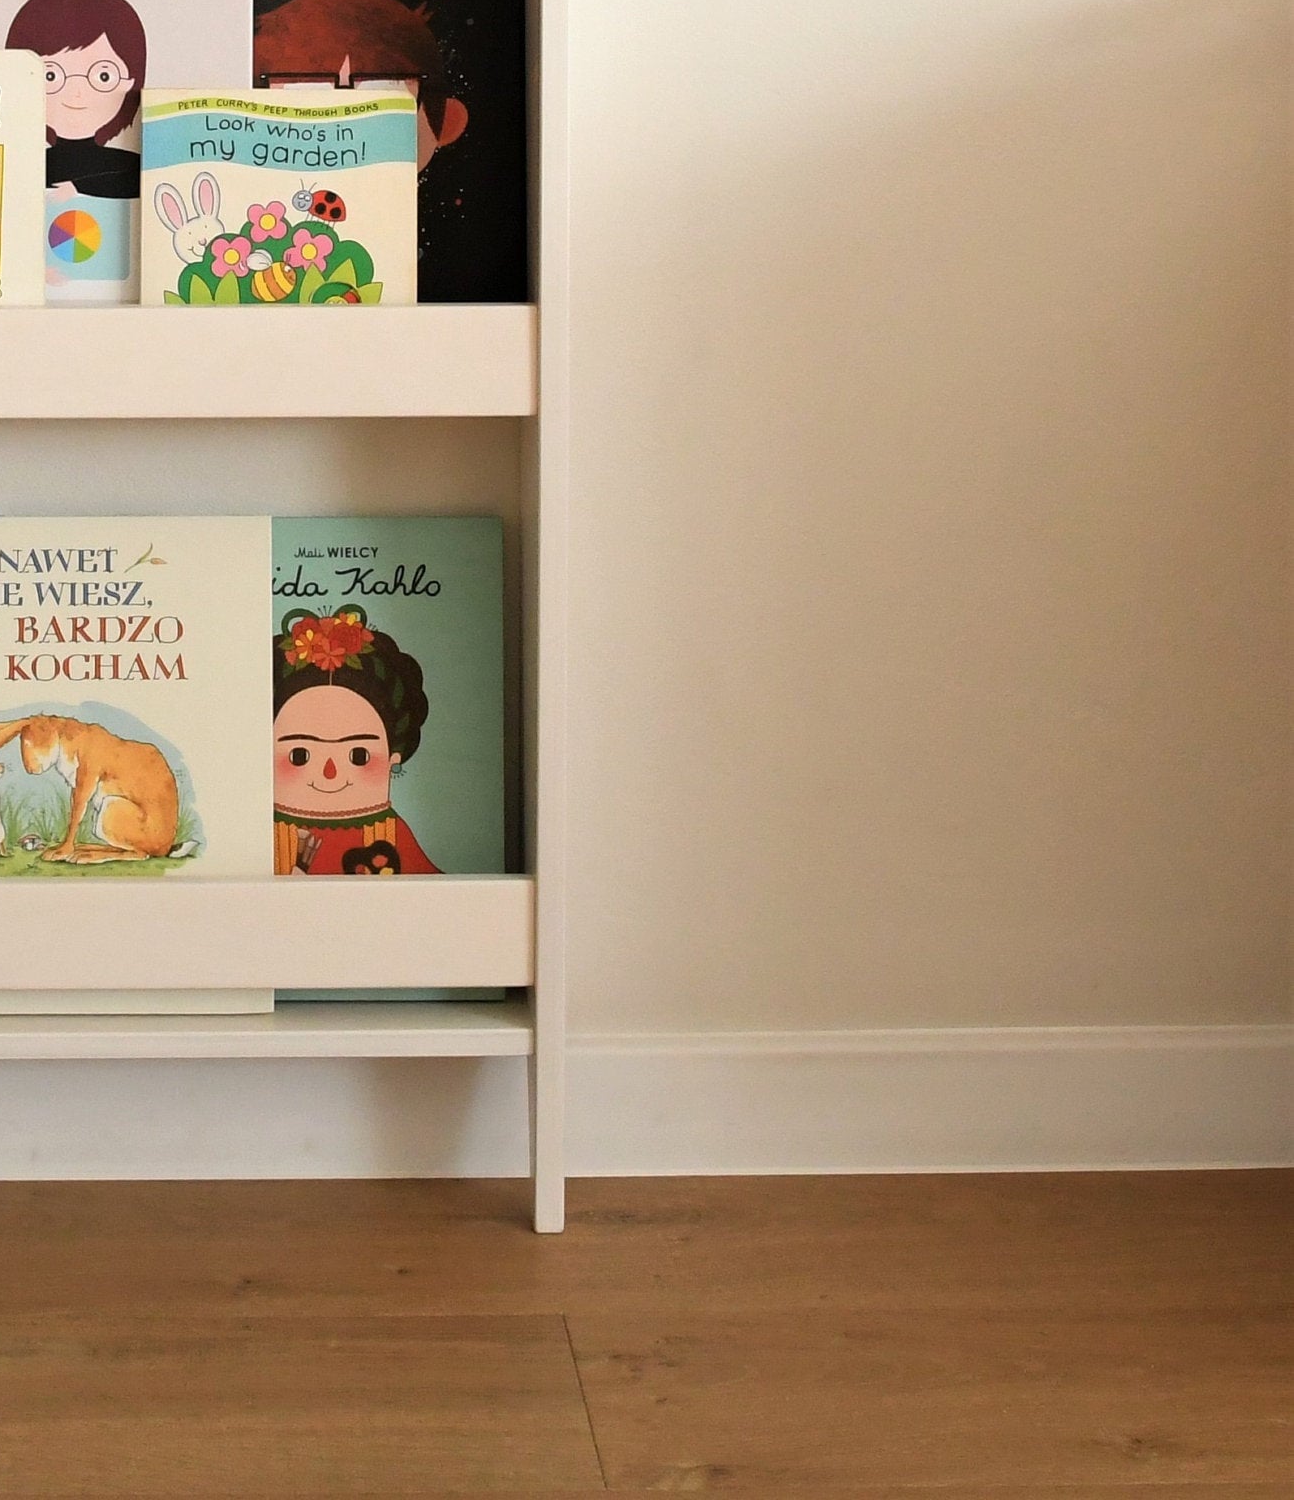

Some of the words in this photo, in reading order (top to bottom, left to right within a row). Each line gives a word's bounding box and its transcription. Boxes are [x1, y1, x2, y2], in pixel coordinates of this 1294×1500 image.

[178, 99, 208, 110] PETER
[216, 99, 258, 111] CURRY'S
[263, 104, 288, 115] PEEP
[293, 108, 338, 117] THROUGH
[344, 103, 379, 115] BOOKS
[206, 115, 255, 132] Look
[267, 123, 326, 142] who's
[336, 124, 354, 141] in
[190, 139, 235, 161] my
[252, 141, 366, 167] garden!
[294, 547, 324, 558] Mali
[327, 547, 379, 558] WIELCY
[272, 564, 328, 597] ida
[335, 564, 441, 597] Kahlo
[32, 581, 153, 608] WIESZ,
[14, 615, 184, 644] BARDZO
[4, 653, 188, 681] KOCHAM
